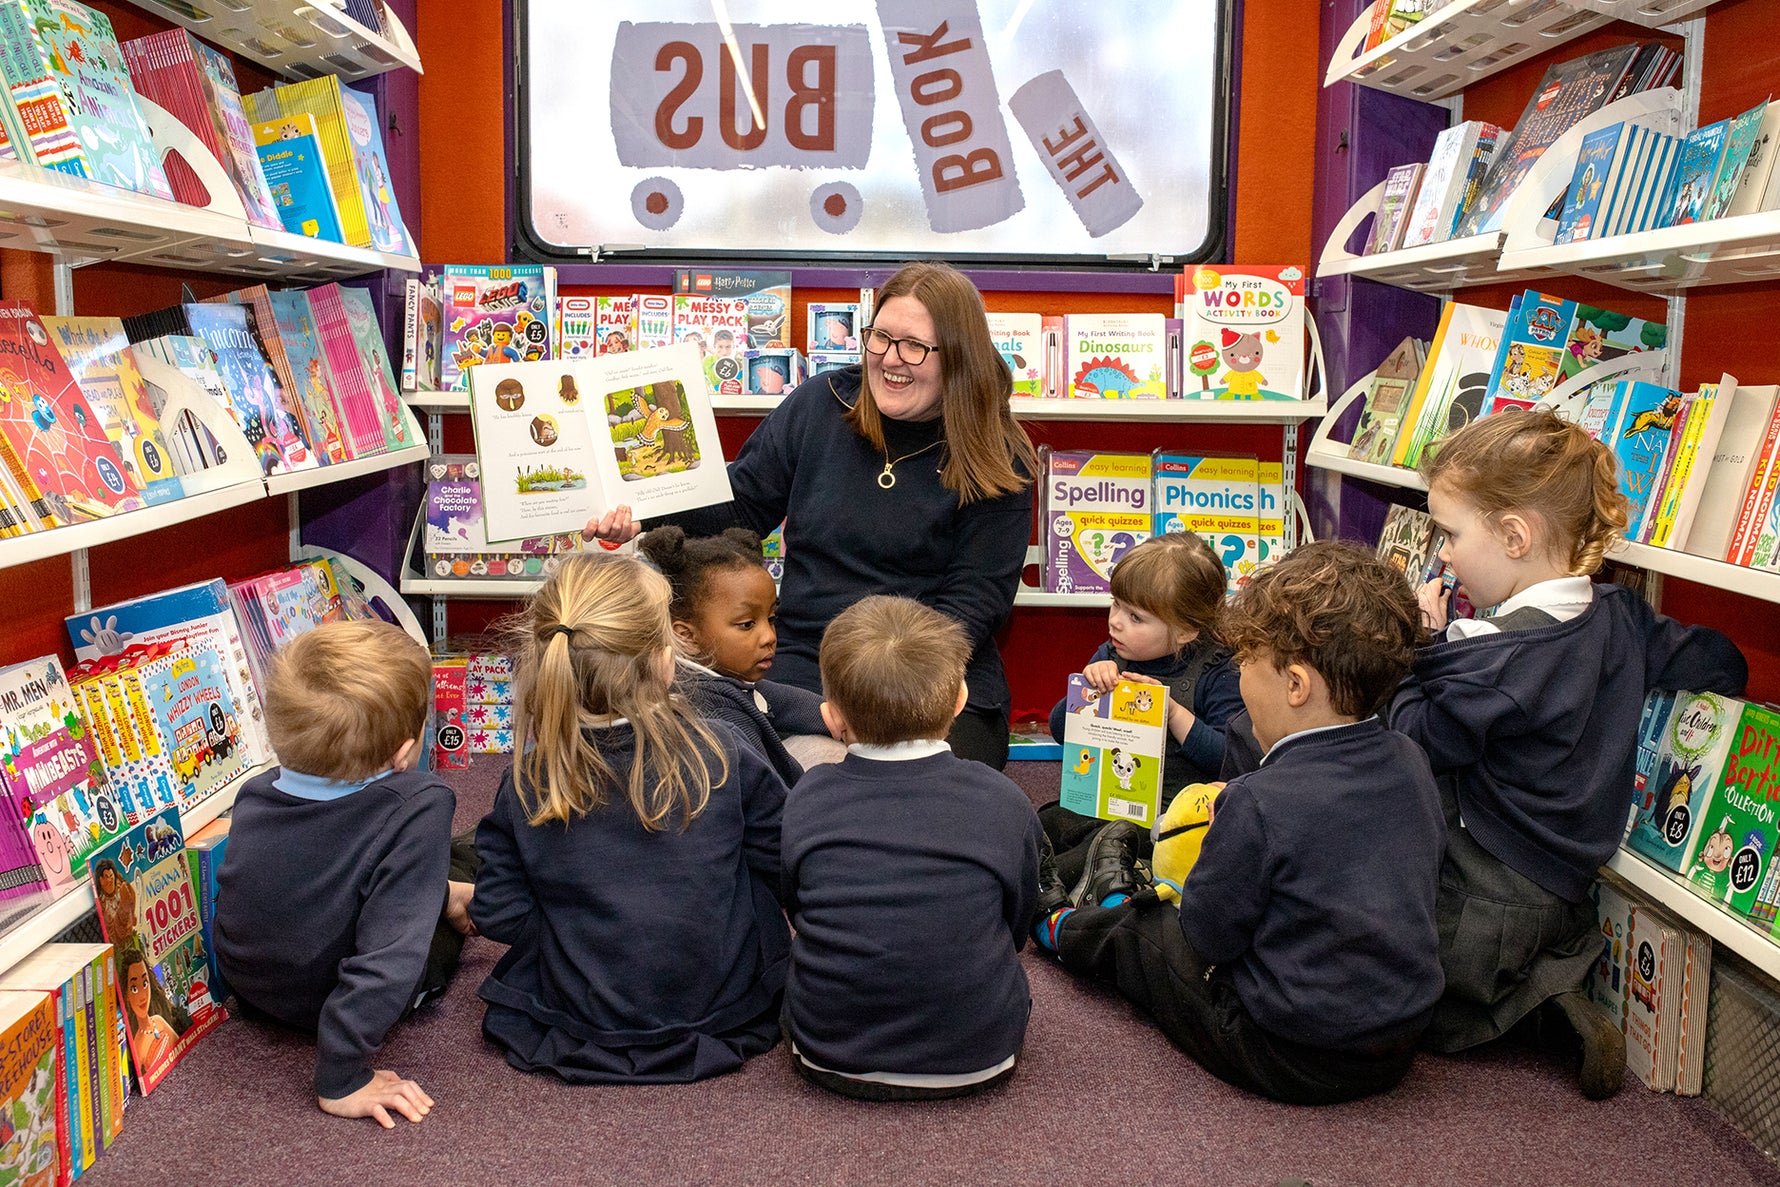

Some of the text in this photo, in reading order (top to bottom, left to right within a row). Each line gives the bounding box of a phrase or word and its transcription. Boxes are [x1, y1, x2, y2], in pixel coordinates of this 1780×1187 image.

[267, 150, 294, 164] Diddle
[449, 267, 543, 279] MORE THAN 1000 STICKERS
[696, 278, 712, 286] LEGO
[480, 283, 520, 304] LEGO
[1225, 281, 1262, 290] My First
[408, 284, 416, 310] FANCY
[456, 291, 474, 301] LEGO
[1203, 291, 1284, 308] WORDS
[691, 302, 731, 314] MESSY
[601, 313, 630, 325] PLAY
[678, 314, 743, 327] PLAY PACK
[1526, 309, 1567, 332] PAW
[57, 322, 87, 346] What
[198, 324, 259, 350] Unicorns
[530, 330, 542, 340] £5
[1109, 330, 1135, 338] Writing
[1458, 332, 1498, 352] WHOS
[1079, 340, 1154, 353] Dinosaurs
[719, 366, 731, 377] £6
[1053, 461, 1077, 470] Collins
[1090, 462, 1147, 474] easy learning
[1165, 464, 1187, 472] Collins
[1199, 466, 1255, 478] easy learning
[106, 472, 120, 487] £4
[441, 486, 471, 494] Charlie
[1054, 481, 1145, 508] Spelling
[1166, 485, 1254, 510] Phonics
[433, 496, 477, 505] Chocolate
[439, 504, 471, 513] Factory
[1733, 458, 1768, 551] KID NORMAL
[1055, 519, 1073, 528] Ages
[1080, 515, 1143, 527] quick quizzes
[1191, 518, 1251, 530] quick quizzes
[1747, 492, 1773, 553] NORMAL
[1055, 540, 1072, 594] Spelling
[157, 632, 170, 640] your
[170, 627, 190, 637] Disney
[190, 622, 209, 631] Junior
[485, 665, 506, 674] PACK
[177, 675, 200, 693] LONDON
[1, 691, 25, 714] MR.
[22, 678, 48, 705] MEN
[166, 686, 221, 723] WHIZZY WHEELS
[122, 713, 135, 743] LONDON
[132, 701, 152, 751] WHIZZY WHEELS
[142, 707, 154, 737] LONDON
[1689, 711, 1717, 734] Children
[94, 712, 114, 762] WHIZZY WHEELS
[103, 718, 116, 747] LONDON
[113, 707, 133, 758] WHIZZY WHEELS
[444, 735, 460, 745] £15
[1724, 786, 1775, 824] COLLECTION
[102, 810, 115, 825] £3
[1674, 811, 1686, 819] ONLY
[1669, 821, 1683, 839] £8
[1739, 852, 1753, 864] ONLY
[145, 867, 182, 898] MOANA
[1735, 865, 1754, 884] £12
[145, 881, 193, 937] 1001
[152, 909, 198, 959] STICKERS
[0, 1021, 51, 1097] REEHOUSE
[168, 1038, 187, 1066] GIANT
